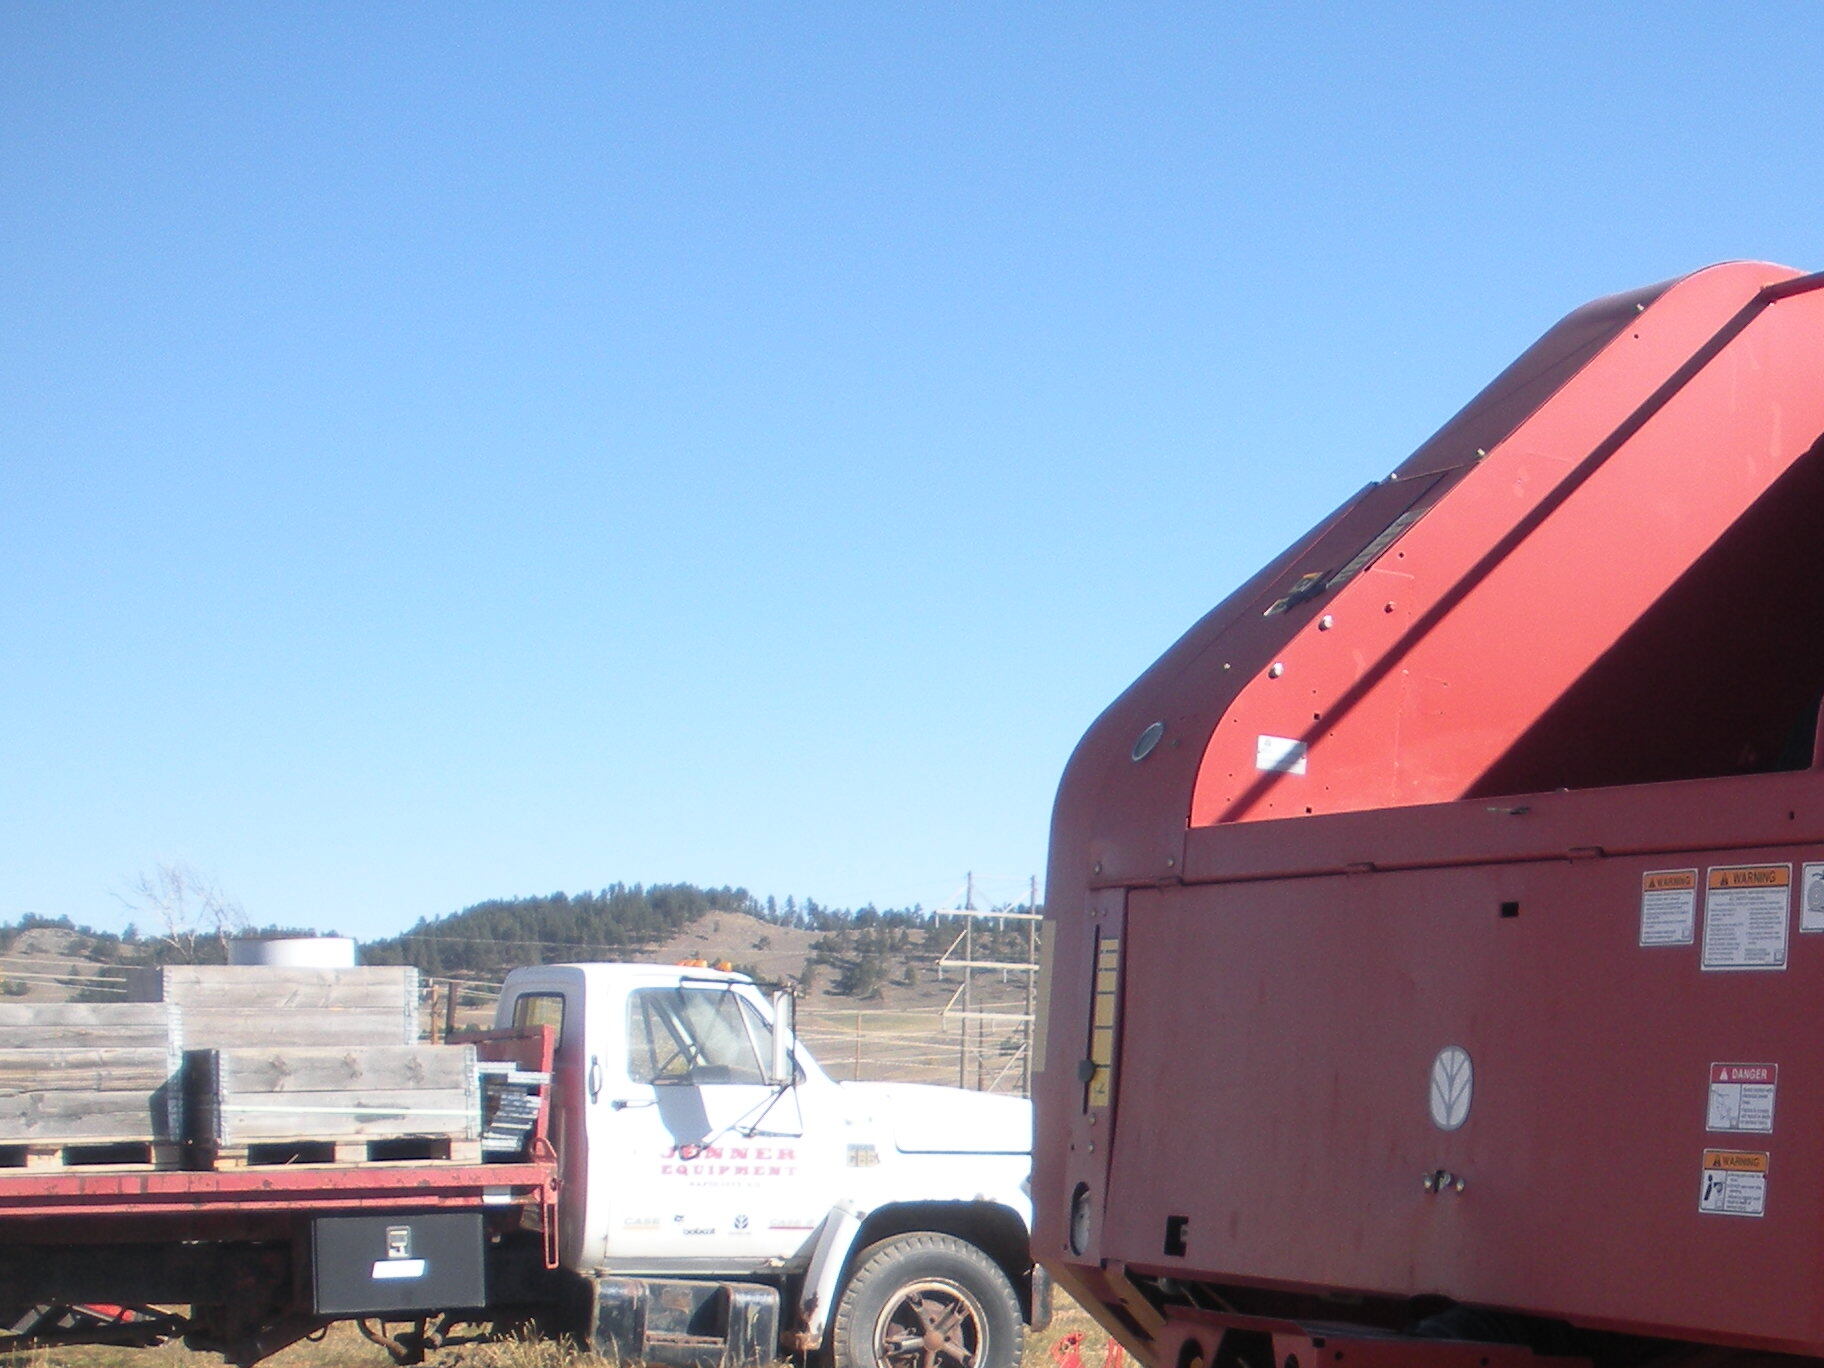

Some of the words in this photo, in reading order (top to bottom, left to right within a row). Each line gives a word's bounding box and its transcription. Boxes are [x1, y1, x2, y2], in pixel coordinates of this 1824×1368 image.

[1657, 876, 1691, 888] WARNING
[1733, 870, 1776, 885] WARNING
[1732, 1068, 1768, 1080] DANGER
[1722, 1155, 1760, 1167] WARNING
[661, 1164, 798, 1176] EQUIPMENT
